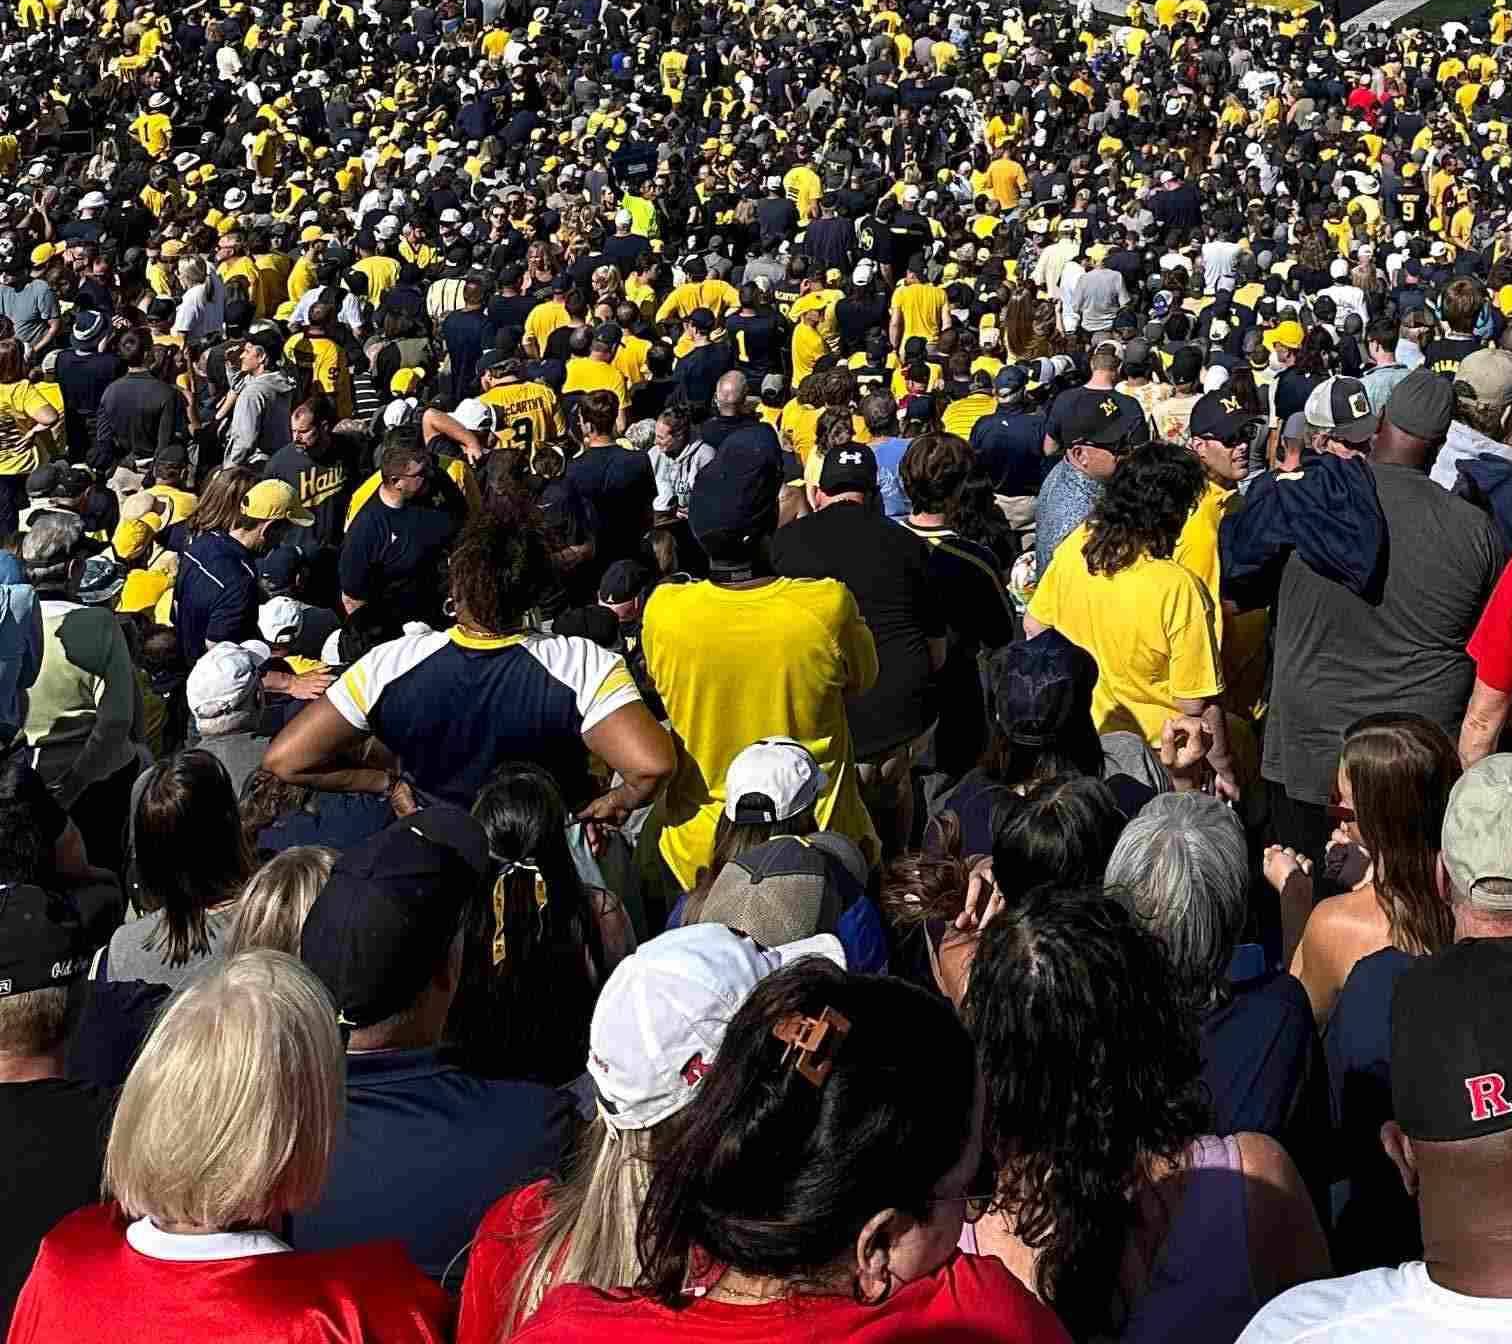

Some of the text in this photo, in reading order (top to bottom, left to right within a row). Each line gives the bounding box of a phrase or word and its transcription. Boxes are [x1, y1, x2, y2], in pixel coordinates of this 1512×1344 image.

[1402, 202, 1415, 221] 9
[736, 329, 750, 362] 1
[1100, 398, 1118, 417] M
[1219, 395, 1243, 415] M
[511, 417, 534, 453] 9
[300, 464, 346, 500] Hail
[1465, 1073, 1512, 1121] R
